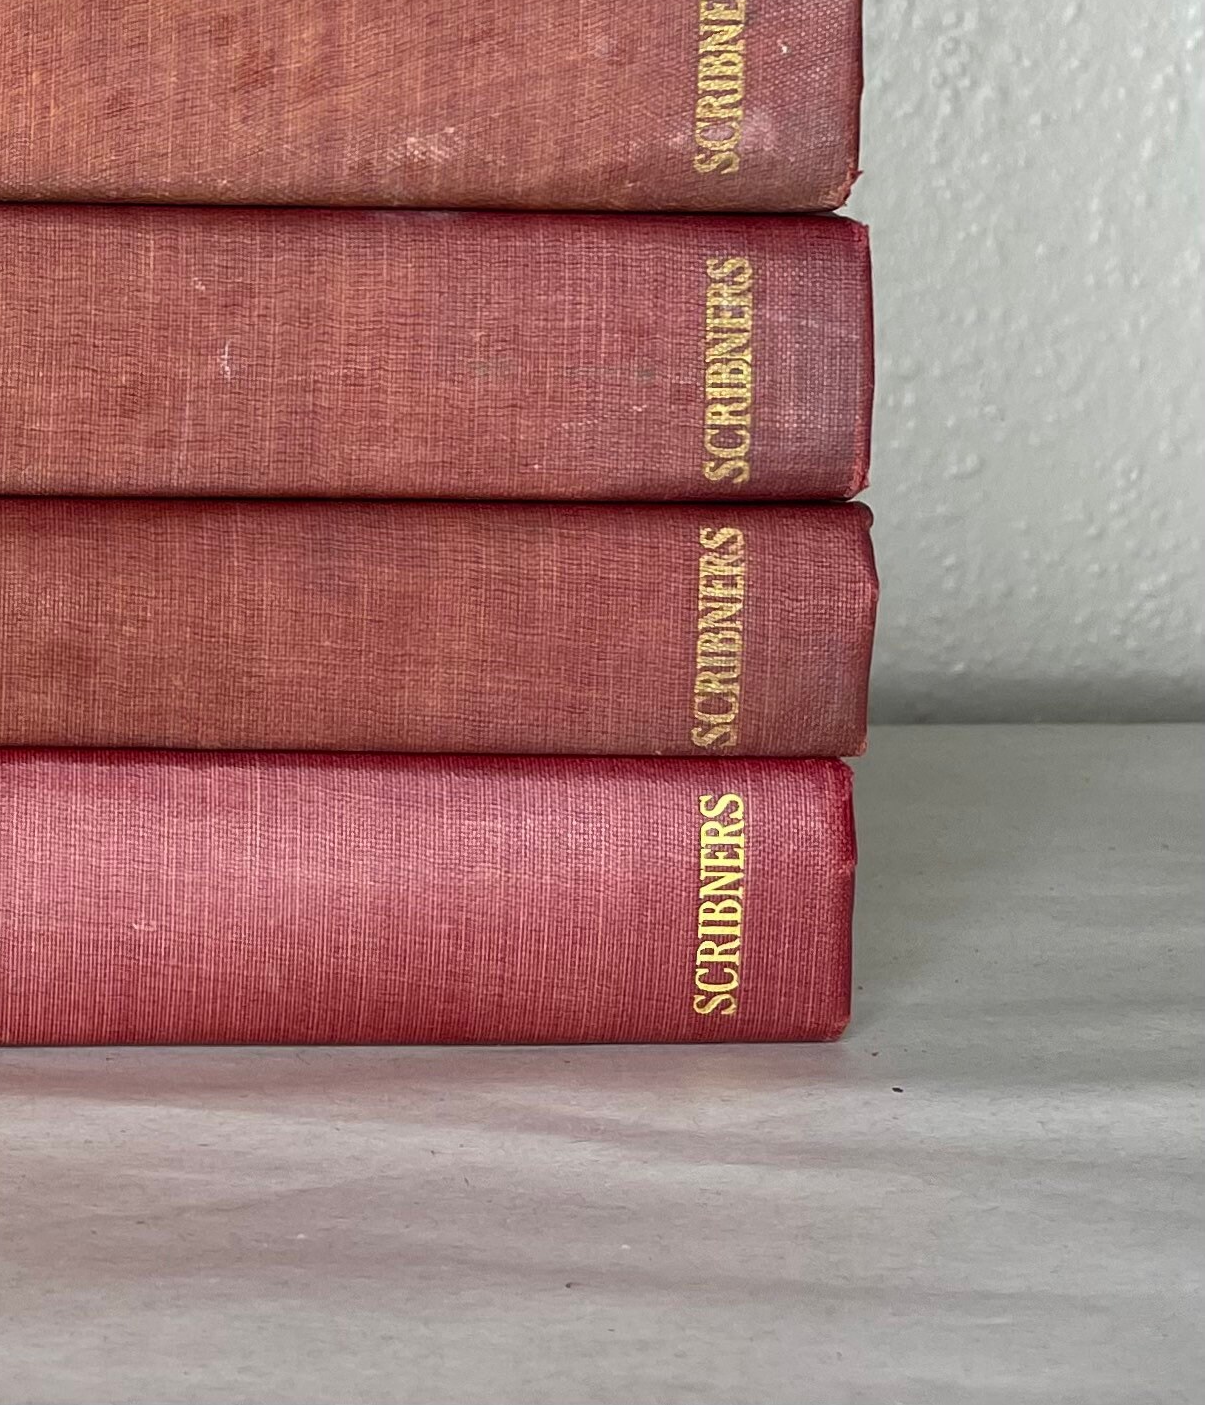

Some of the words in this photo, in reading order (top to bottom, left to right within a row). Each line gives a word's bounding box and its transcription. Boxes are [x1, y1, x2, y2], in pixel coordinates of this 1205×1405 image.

[703, 255, 754, 484] SCRIBNERS
[690, 526, 745, 752] SCRIBNERS
[693, 793, 745, 1016] SCRIBNERS
